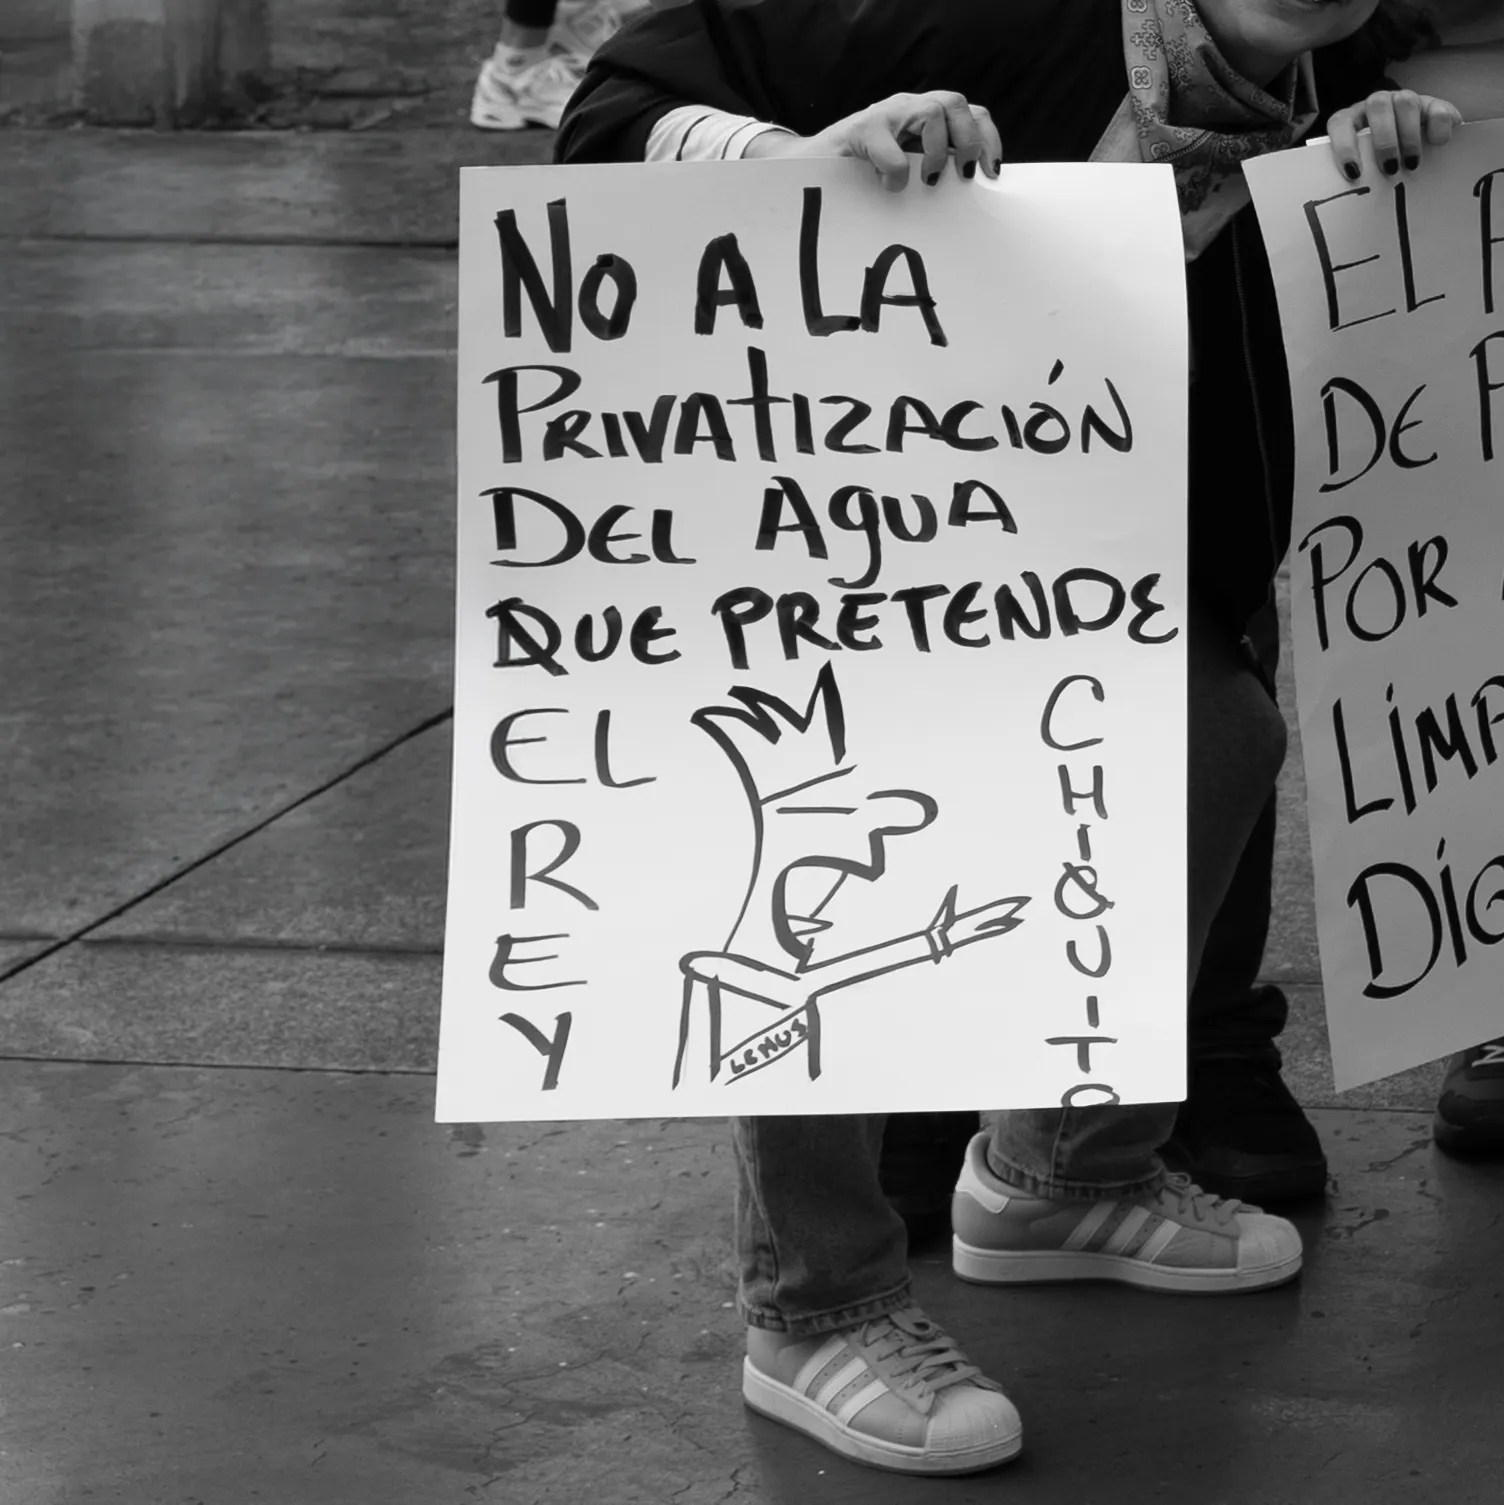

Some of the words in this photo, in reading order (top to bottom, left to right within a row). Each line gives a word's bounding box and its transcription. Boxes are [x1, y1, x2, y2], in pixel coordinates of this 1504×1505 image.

[695, 233, 763, 335] A
[800, 187, 947, 347] LA
[1304, 181, 1445, 332] EL
[479, 487, 696, 567] DEL
[1298, 516, 1458, 651] POR
[486, 597, 681, 676] QUE
[711, 568, 1178, 669] PRETENDE
[490, 708, 656, 788] EL
[488, 819, 598, 1091] REY
[1039, 675, 1120, 1109] CHIQUITO
